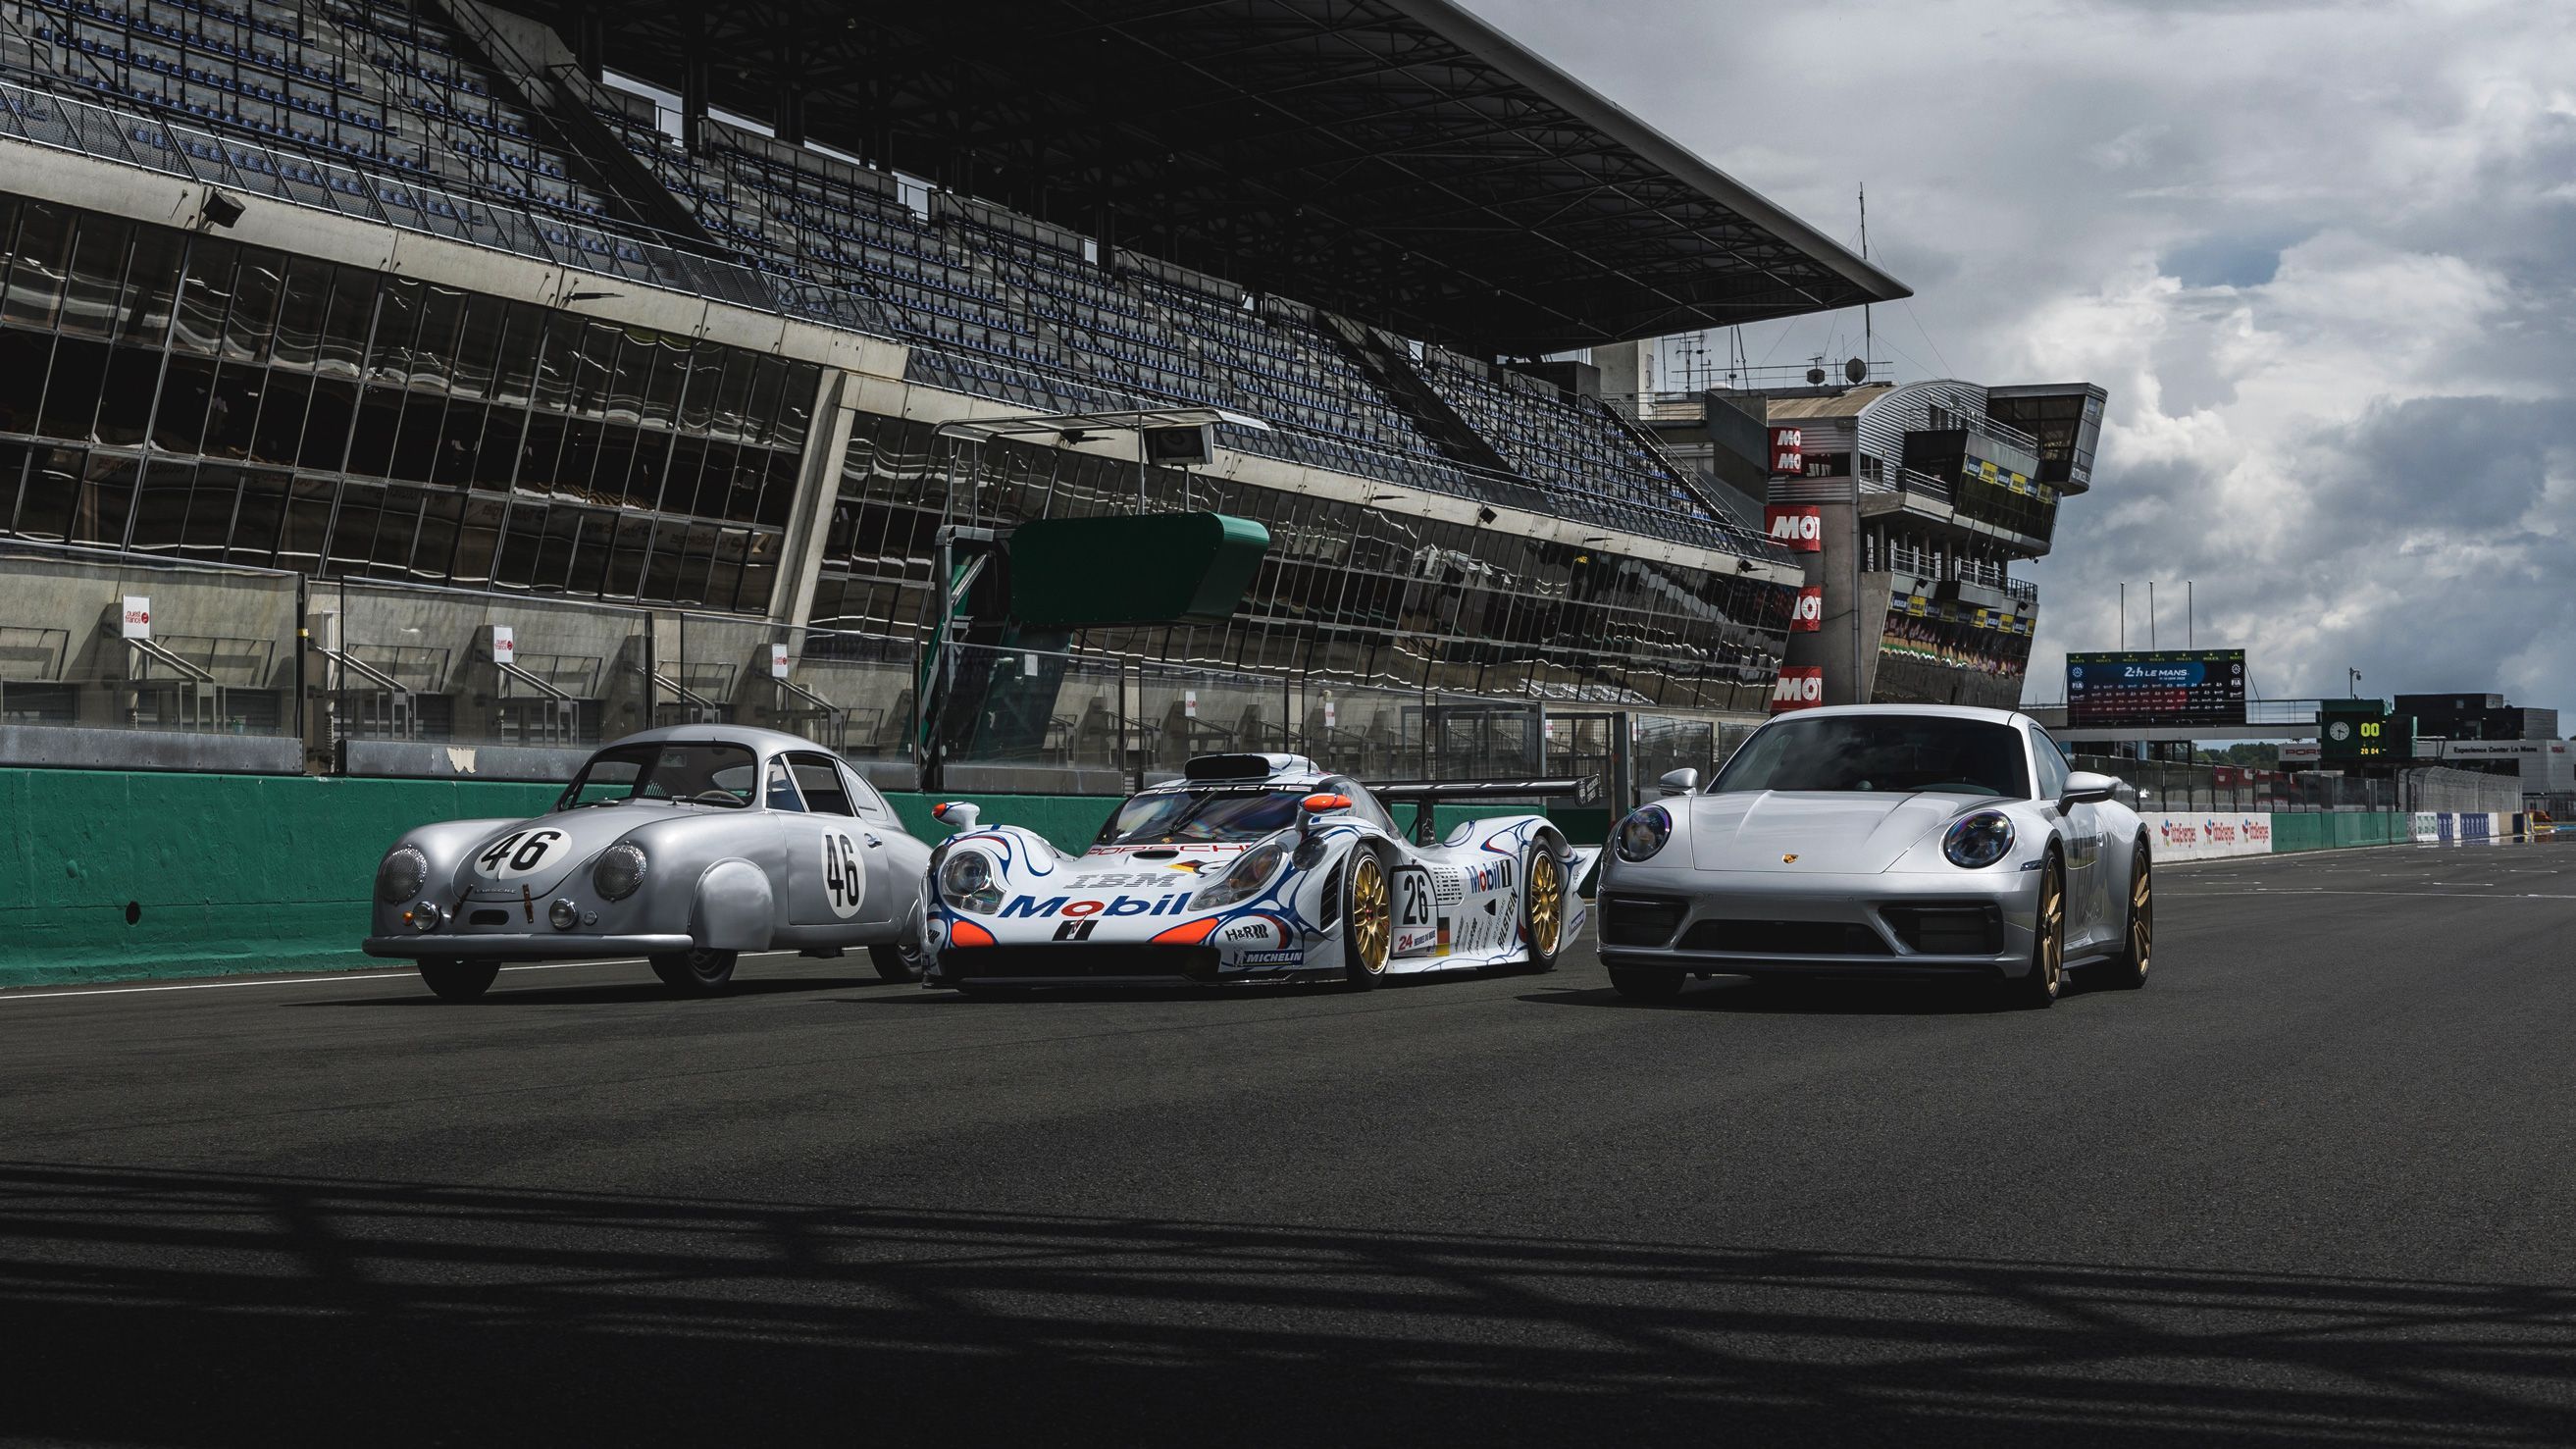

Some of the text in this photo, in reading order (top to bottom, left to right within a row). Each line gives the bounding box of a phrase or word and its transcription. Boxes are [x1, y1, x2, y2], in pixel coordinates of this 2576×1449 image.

[2360, 722, 2380, 737] 00
[481, 830, 561, 871] 46
[1086, 845, 1251, 856] PORSCH
[826, 834, 859, 907] 46
[1063, 873, 1187, 889] IBM
[1466, 860, 1501, 894] Mobil
[998, 892, 1193, 918] Mobil
[1403, 875, 1428, 925] 26
[1497, 887, 1519, 952] BILSTEIN
[1224, 925, 1255, 942] H&R
[1398, 933, 1414, 951] 24
[1246, 952, 1303, 962] MICHELIN
